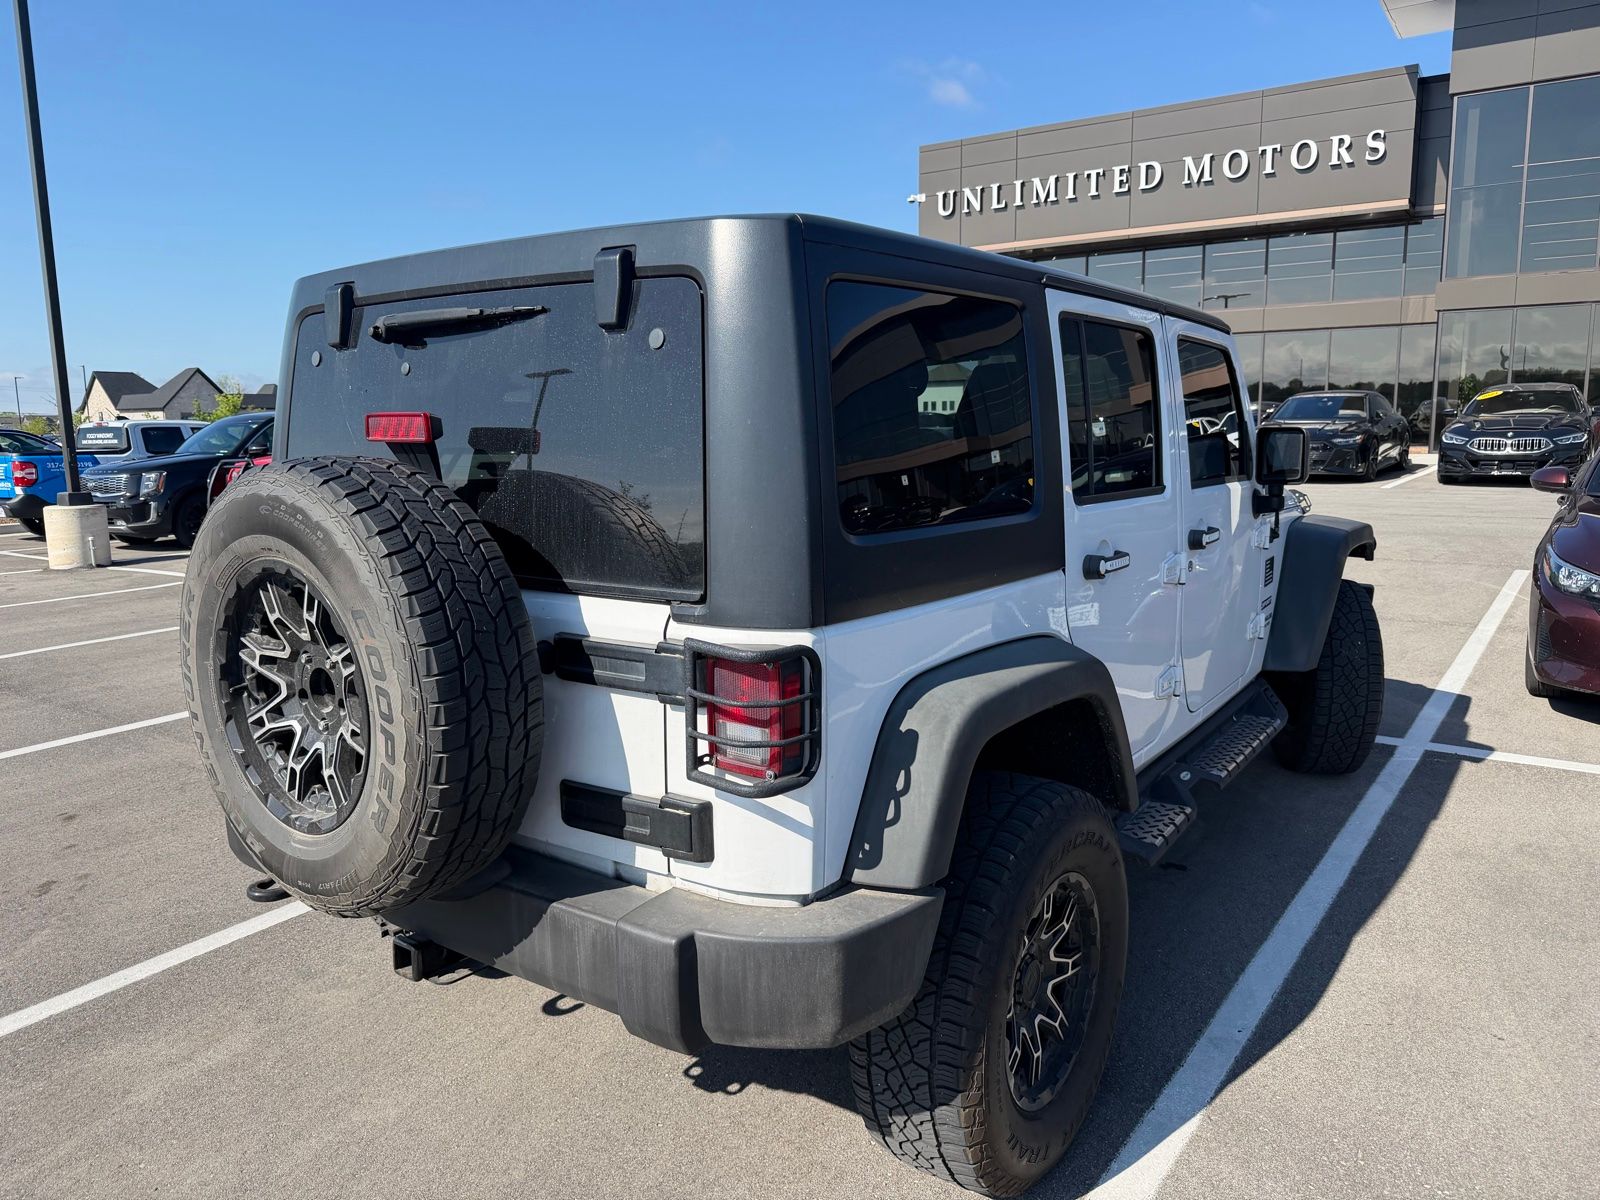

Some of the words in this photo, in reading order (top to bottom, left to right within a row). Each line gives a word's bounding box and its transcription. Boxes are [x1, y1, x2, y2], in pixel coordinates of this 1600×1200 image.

[937, 161, 1163, 217] UNLIMITED
[1182, 129, 1387, 185] MOTORS
[351, 609, 396, 834] COOPER
